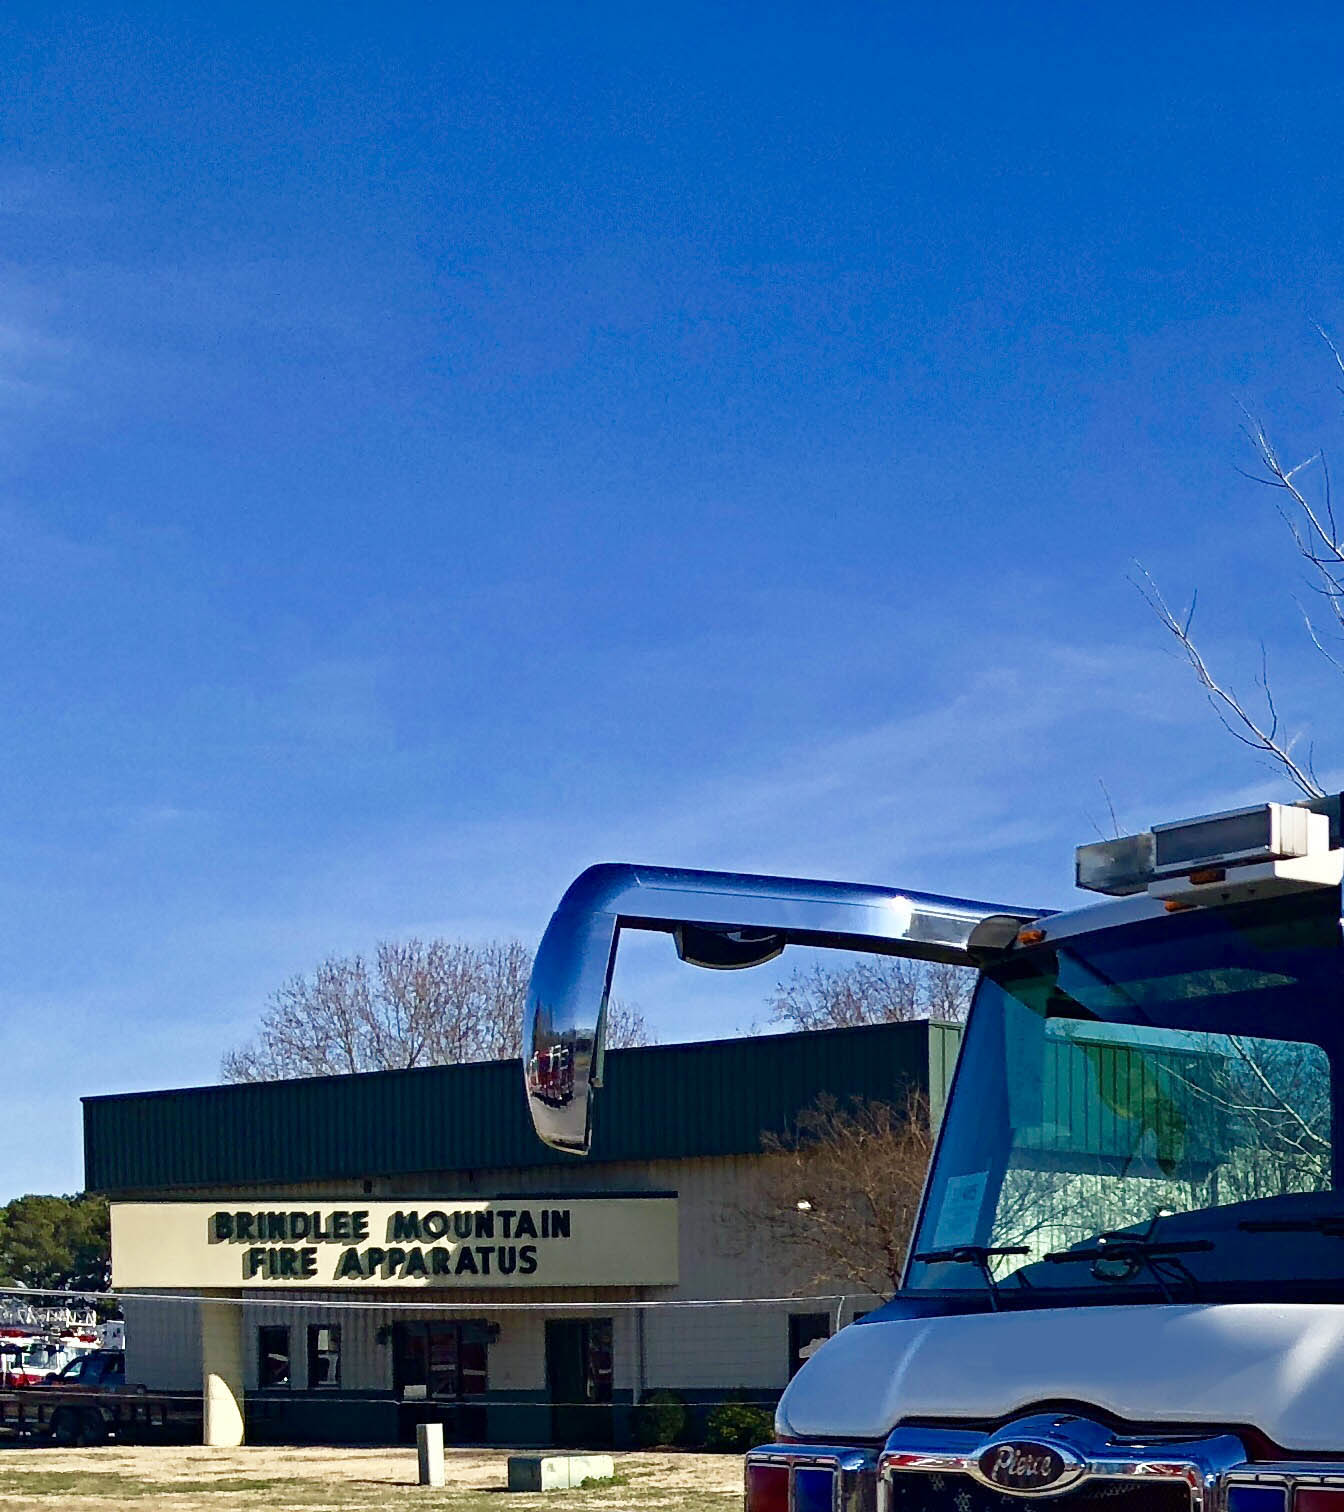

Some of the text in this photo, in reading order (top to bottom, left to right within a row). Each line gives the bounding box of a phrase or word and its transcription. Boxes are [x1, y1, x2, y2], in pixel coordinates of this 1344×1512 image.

[209, 1209, 571, 1243] BRINDLEE MOUNTAIN
[244, 1245, 538, 1279] FIRE APPARATUS
[992, 1445, 1052, 1482] Pierce
